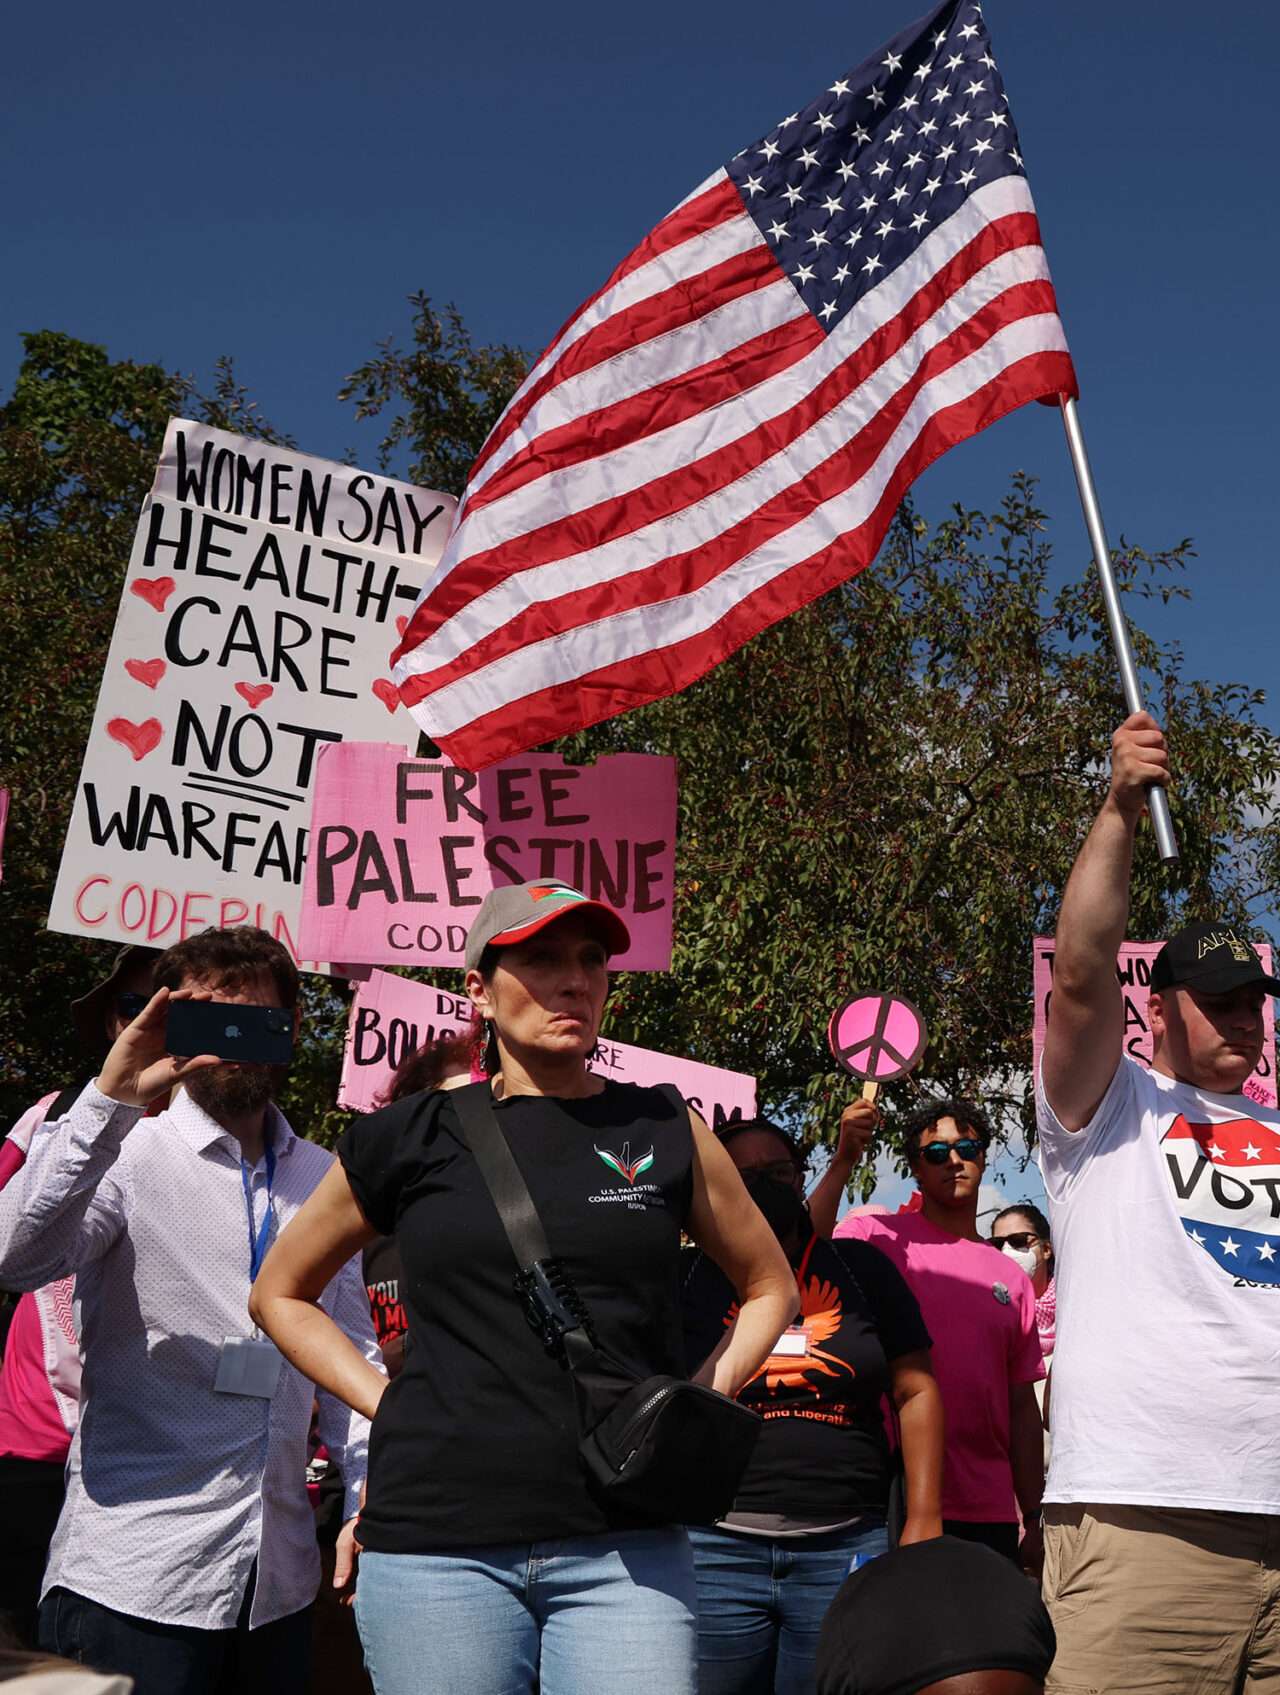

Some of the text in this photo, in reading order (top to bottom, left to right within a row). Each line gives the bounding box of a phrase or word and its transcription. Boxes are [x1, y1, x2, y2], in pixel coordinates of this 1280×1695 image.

[176, 431, 445, 555] WOMEN SAY
[164, 597, 358, 699] CARE
[171, 699, 342, 789] NOT
[83, 783, 309, 885] WARFA
[395, 761, 591, 828] FREE
[316, 825, 668, 914] PALESTINE
[75, 873, 325, 972] CODEPIN
[588, 1193, 643, 1203] COMMUNITY
[367, 1279, 399, 1307] YOU
[794, 1409, 851, 1425] Liberati
